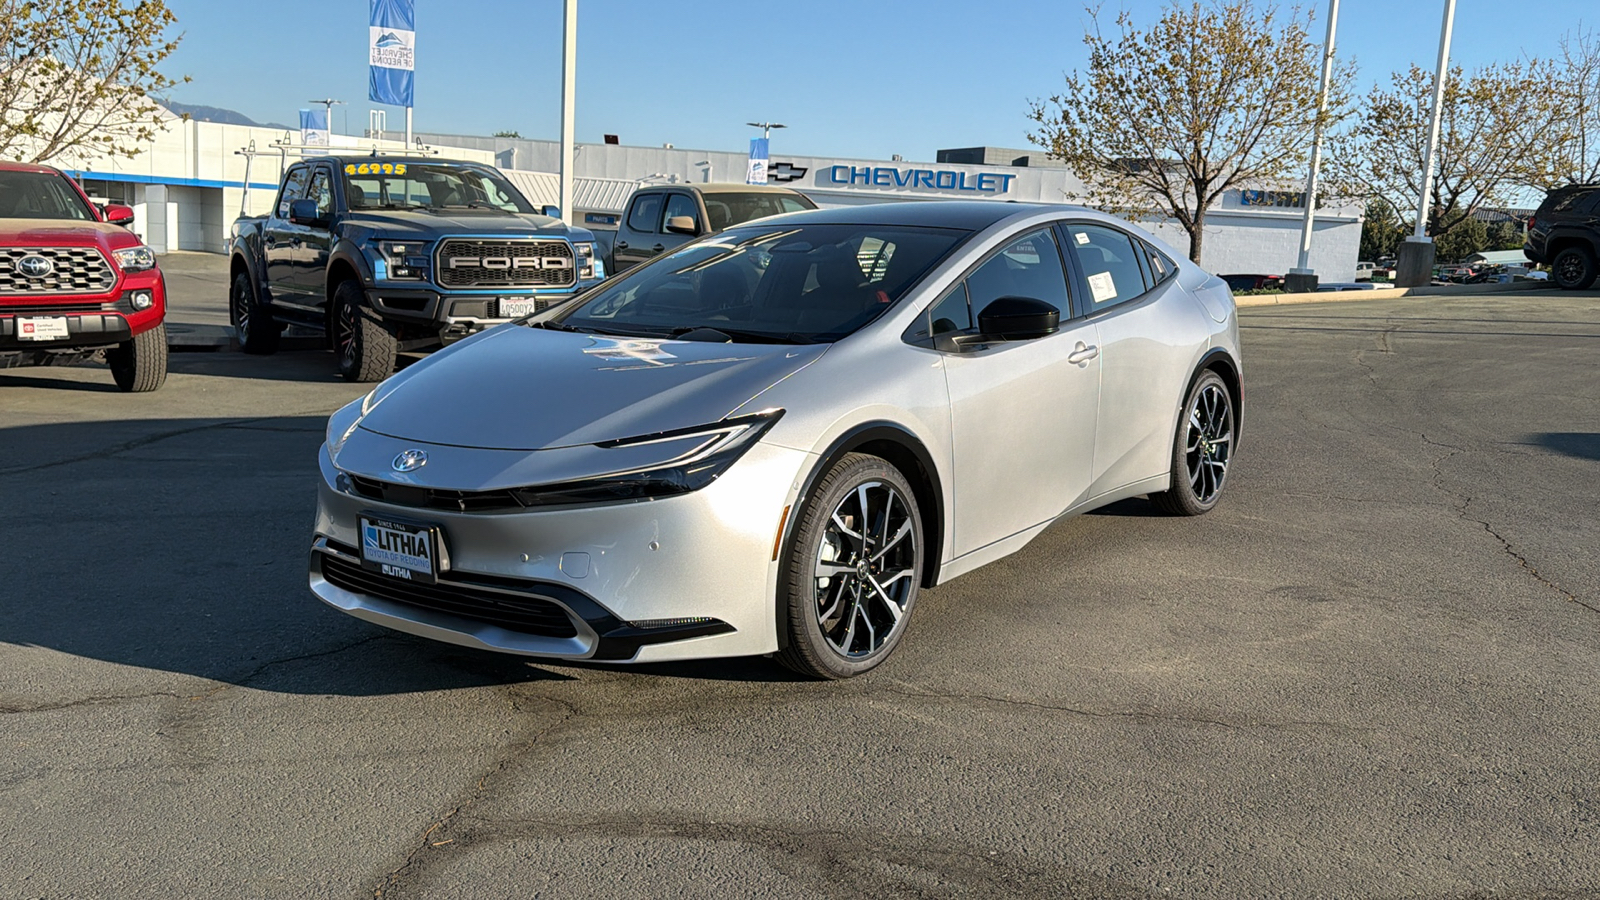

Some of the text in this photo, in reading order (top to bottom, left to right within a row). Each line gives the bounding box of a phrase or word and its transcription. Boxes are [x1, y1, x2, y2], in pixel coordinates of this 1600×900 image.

[345, 163, 406, 175] 46995
[831, 165, 1017, 193] CHEVROLET
[450, 257, 567, 268] FORD
[377, 520, 392, 529] SINCE
[377, 529, 428, 559] LITHIA
[366, 548, 430, 569] TOYOTA OF REDDING
[388, 565, 412, 580] LITHIA
